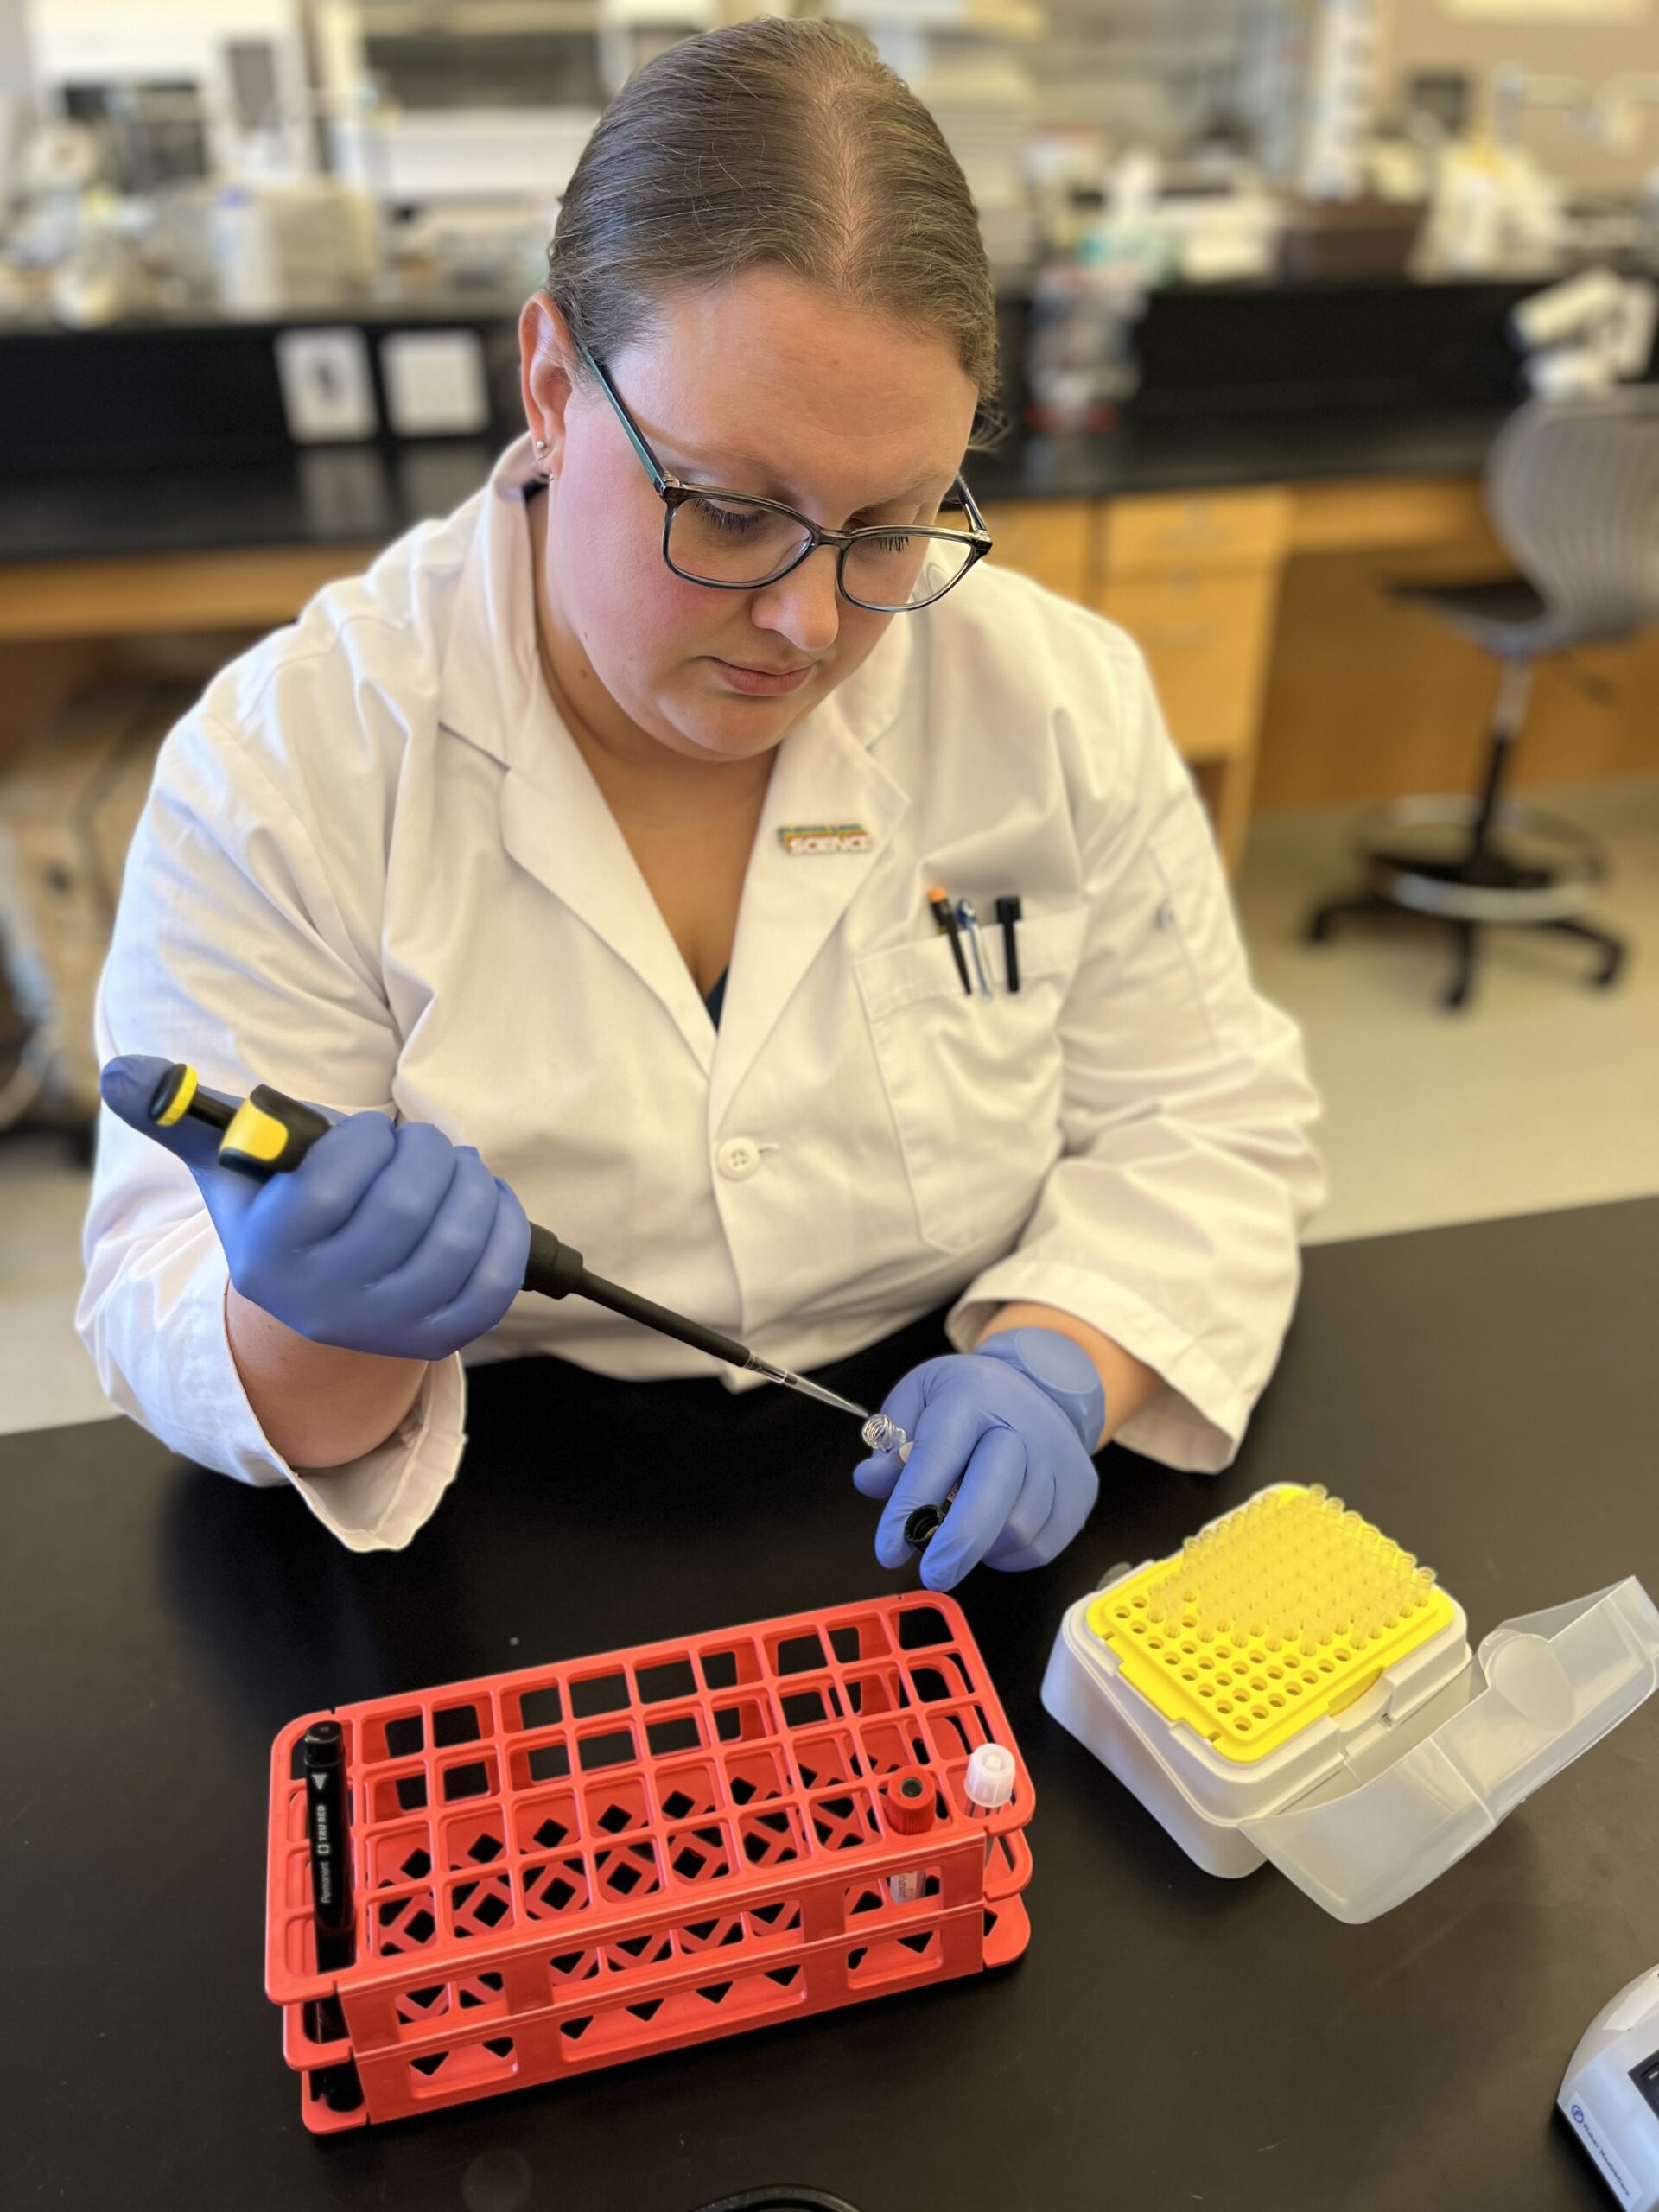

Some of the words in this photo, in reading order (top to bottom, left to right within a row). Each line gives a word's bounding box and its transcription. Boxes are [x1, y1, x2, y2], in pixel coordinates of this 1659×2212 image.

[317, 1805, 327, 1823] RED
[318, 1824, 327, 1841] TRU
[320, 1861, 331, 1903] Permanent
